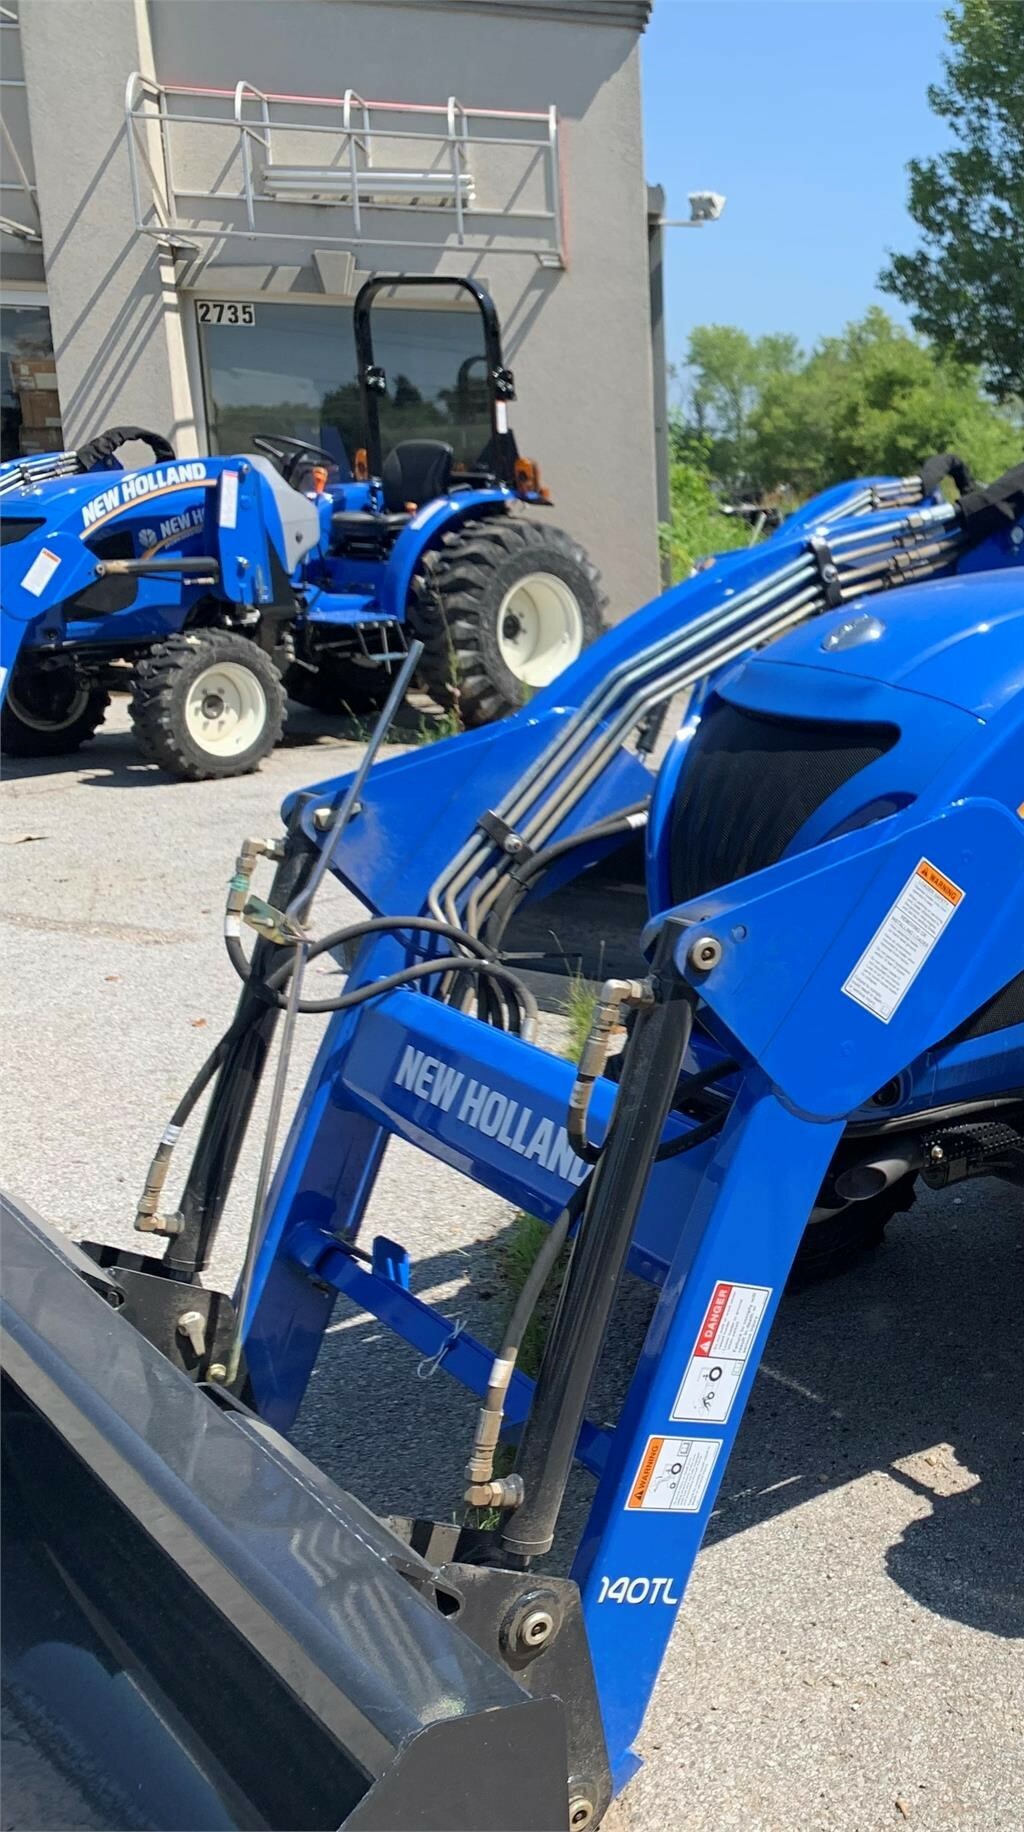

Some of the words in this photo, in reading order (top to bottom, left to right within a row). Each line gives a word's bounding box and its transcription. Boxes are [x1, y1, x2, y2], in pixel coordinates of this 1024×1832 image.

[199, 303, 253, 324] 2735
[81, 486, 120, 527] NEW
[121, 462, 207, 501] HOLLAND
[160, 512, 190, 540] NEW
[929, 873, 957, 900] WARNING
[394, 1045, 464, 1112] NEW
[704, 1289, 728, 1339] DANGER
[639, 1445, 659, 1489] WARNING
[598, 1576, 678, 1604] 140TL
